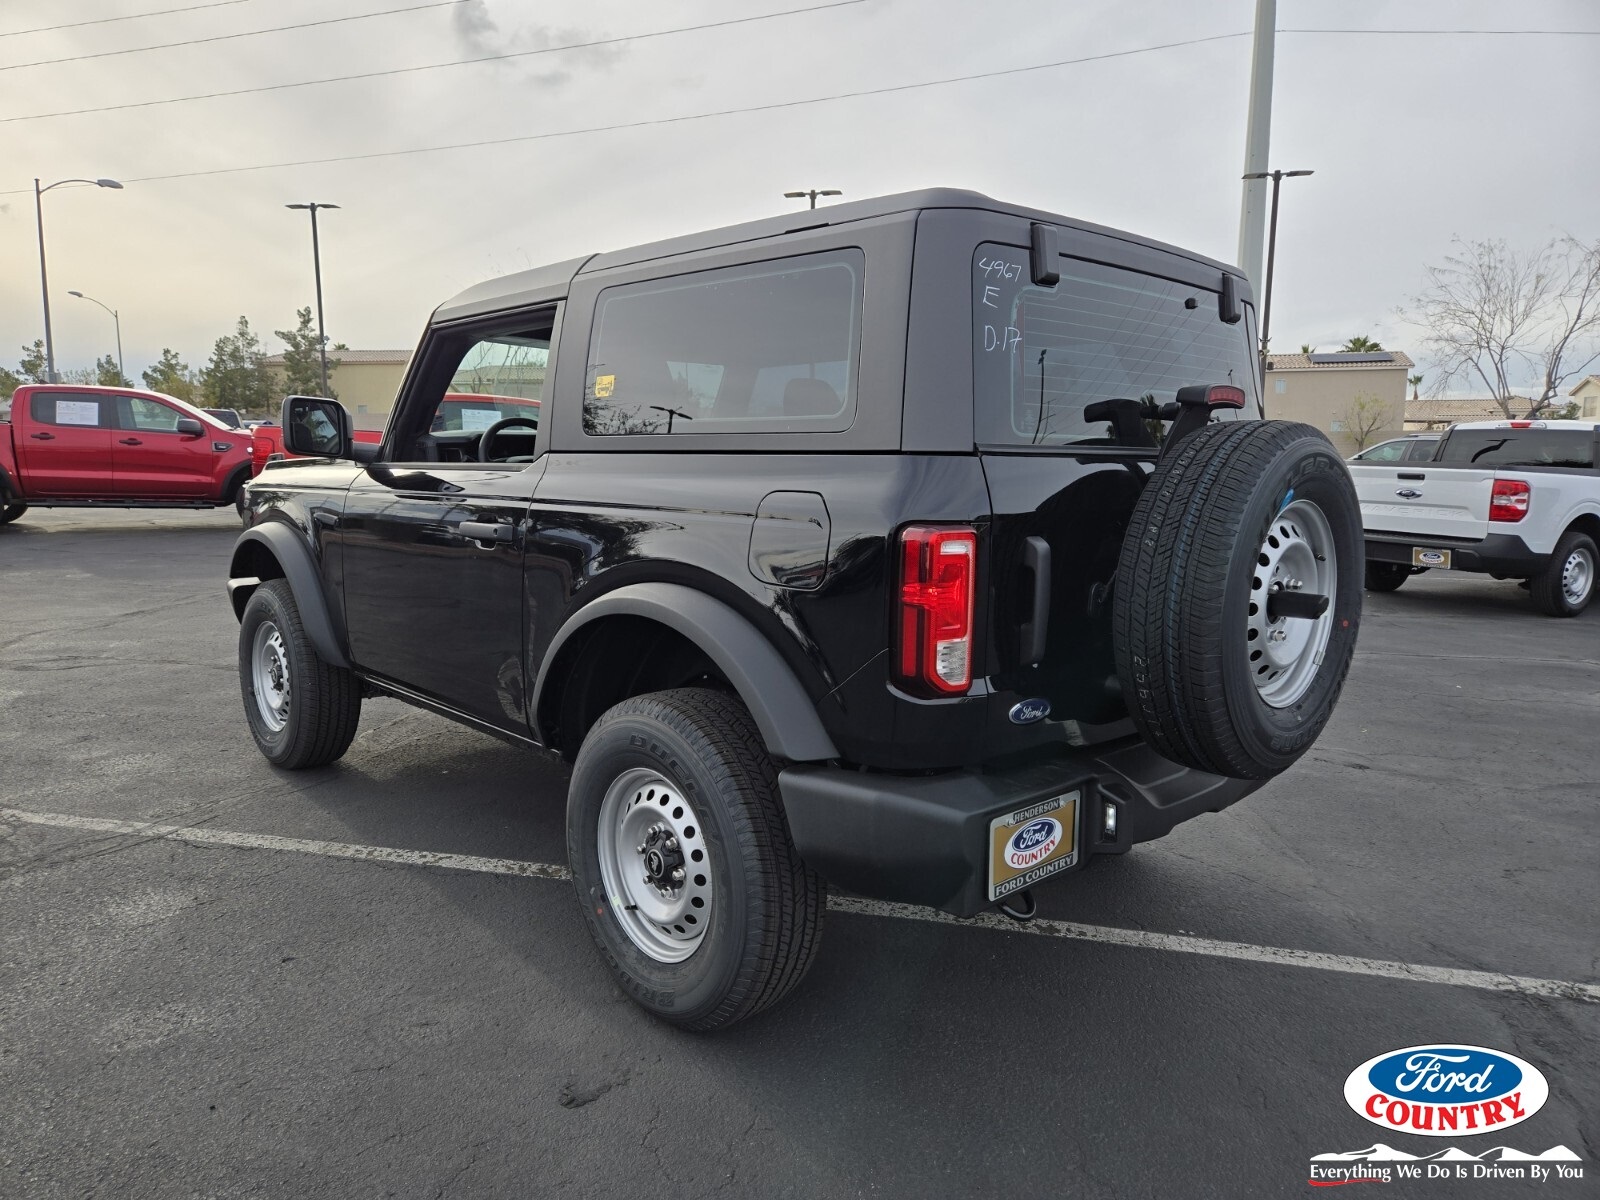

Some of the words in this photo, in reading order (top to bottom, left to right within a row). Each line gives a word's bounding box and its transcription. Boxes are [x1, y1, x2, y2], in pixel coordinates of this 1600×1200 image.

[979, 257, 1022, 283] 4967
[982, 285, 1000, 308] E
[1013, 799, 1060, 822] HENDERSON
[1019, 823, 1049, 849] Ford
[1010, 837, 1058, 866] COUNTRY
[994, 875, 1025, 897] FORD
[1025, 855, 1073, 883] COUNTRY
